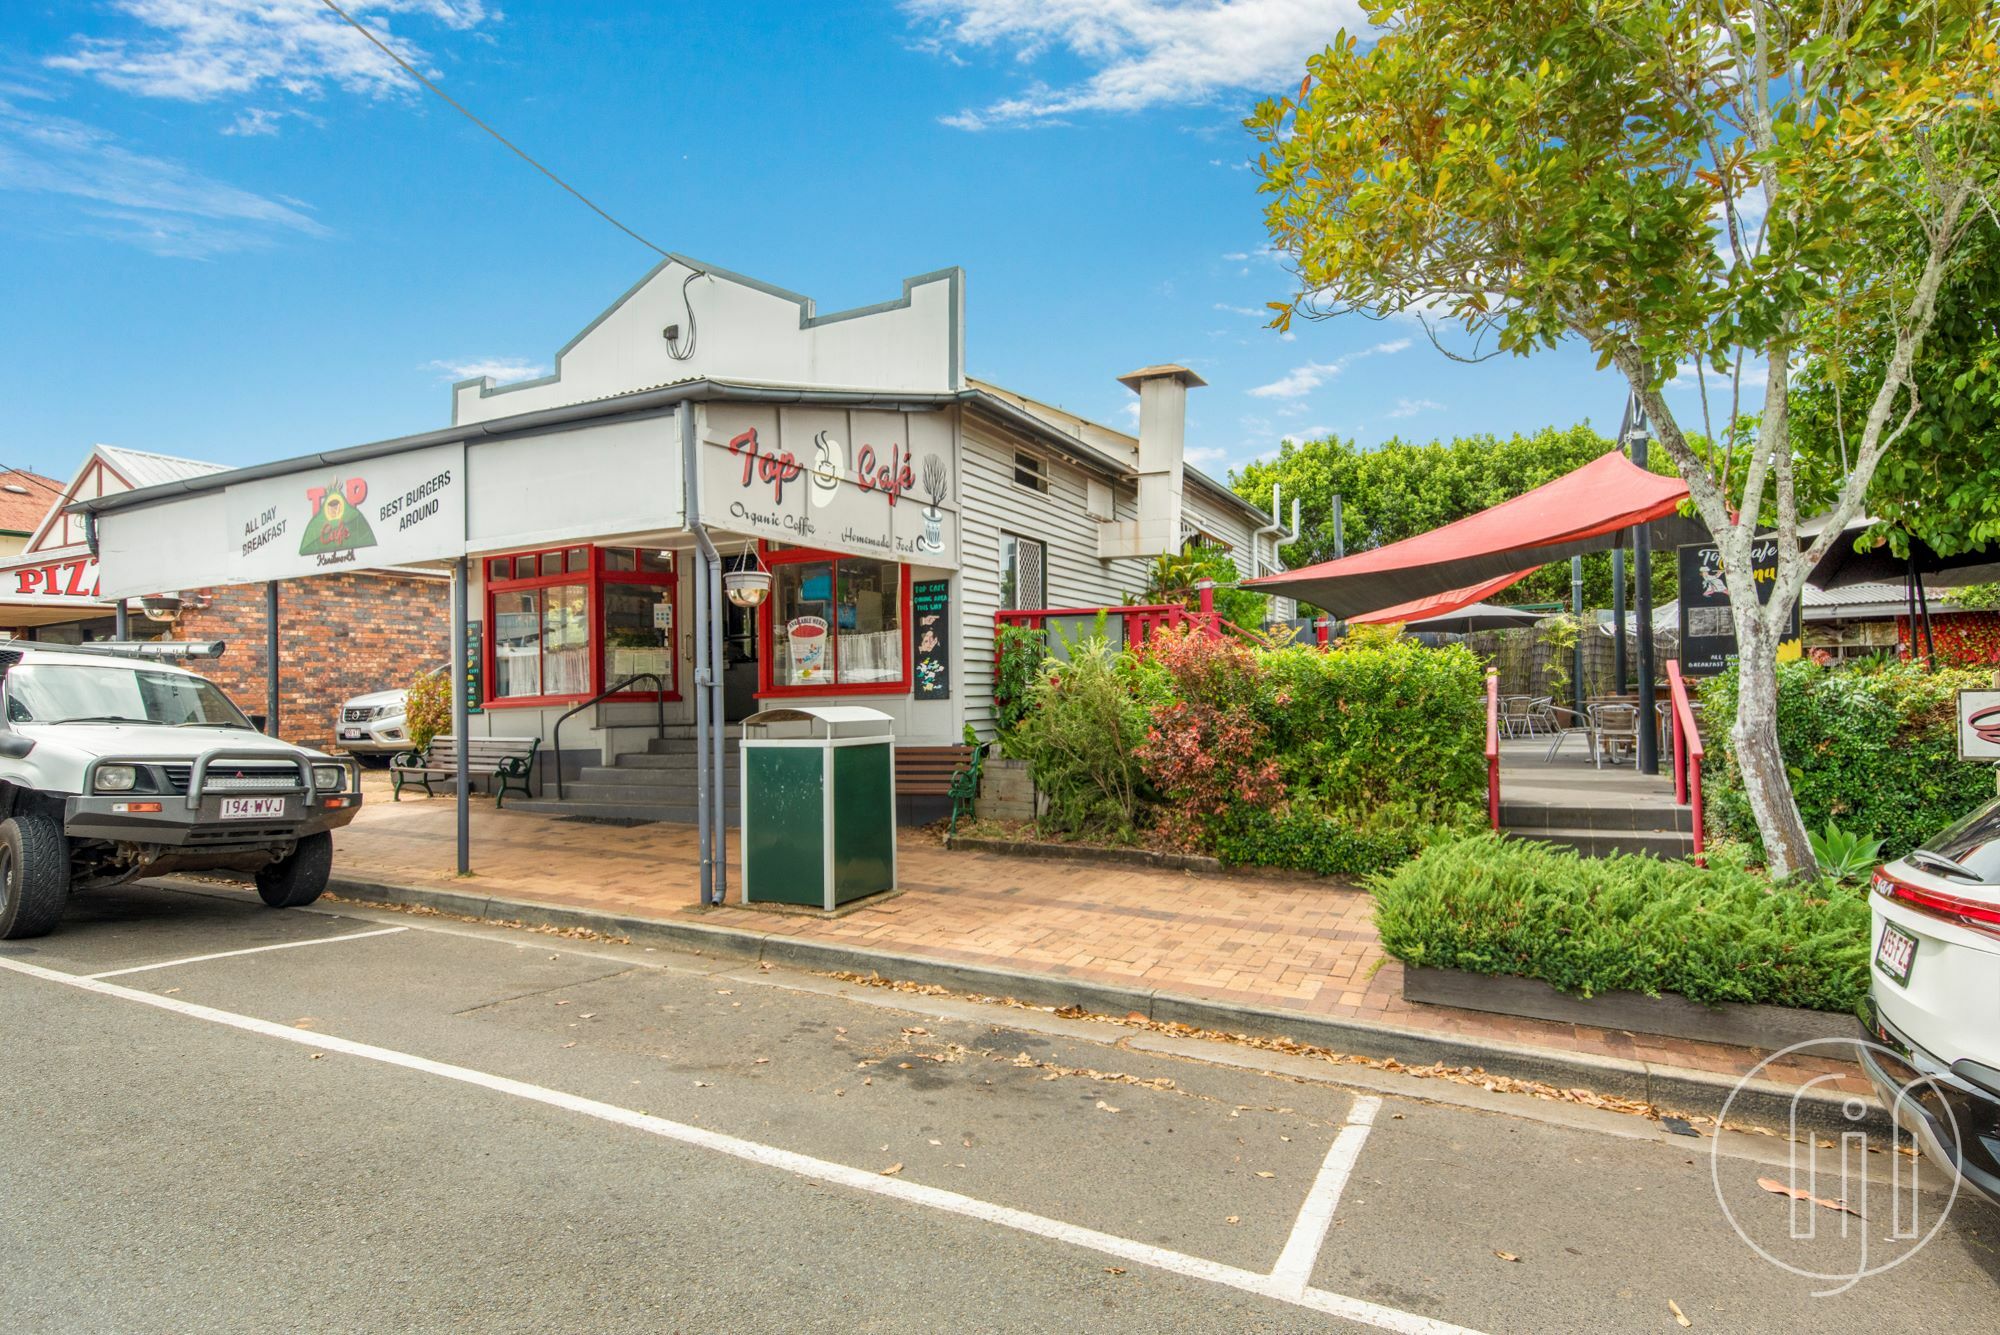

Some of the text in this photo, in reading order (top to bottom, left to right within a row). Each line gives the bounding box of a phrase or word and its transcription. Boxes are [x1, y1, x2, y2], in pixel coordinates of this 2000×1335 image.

[728, 426, 916, 507] Top Café
[380, 470, 451, 522] BEST BURGERS
[244, 505, 277, 537] ALL DAY
[399, 498, 439, 532] AROUND
[730, 501, 780, 527] Organic
[242, 519, 287, 557] BREAKFAST
[841, 527, 914, 553] Homemade Food
[1751, 541, 1778, 563] afe
